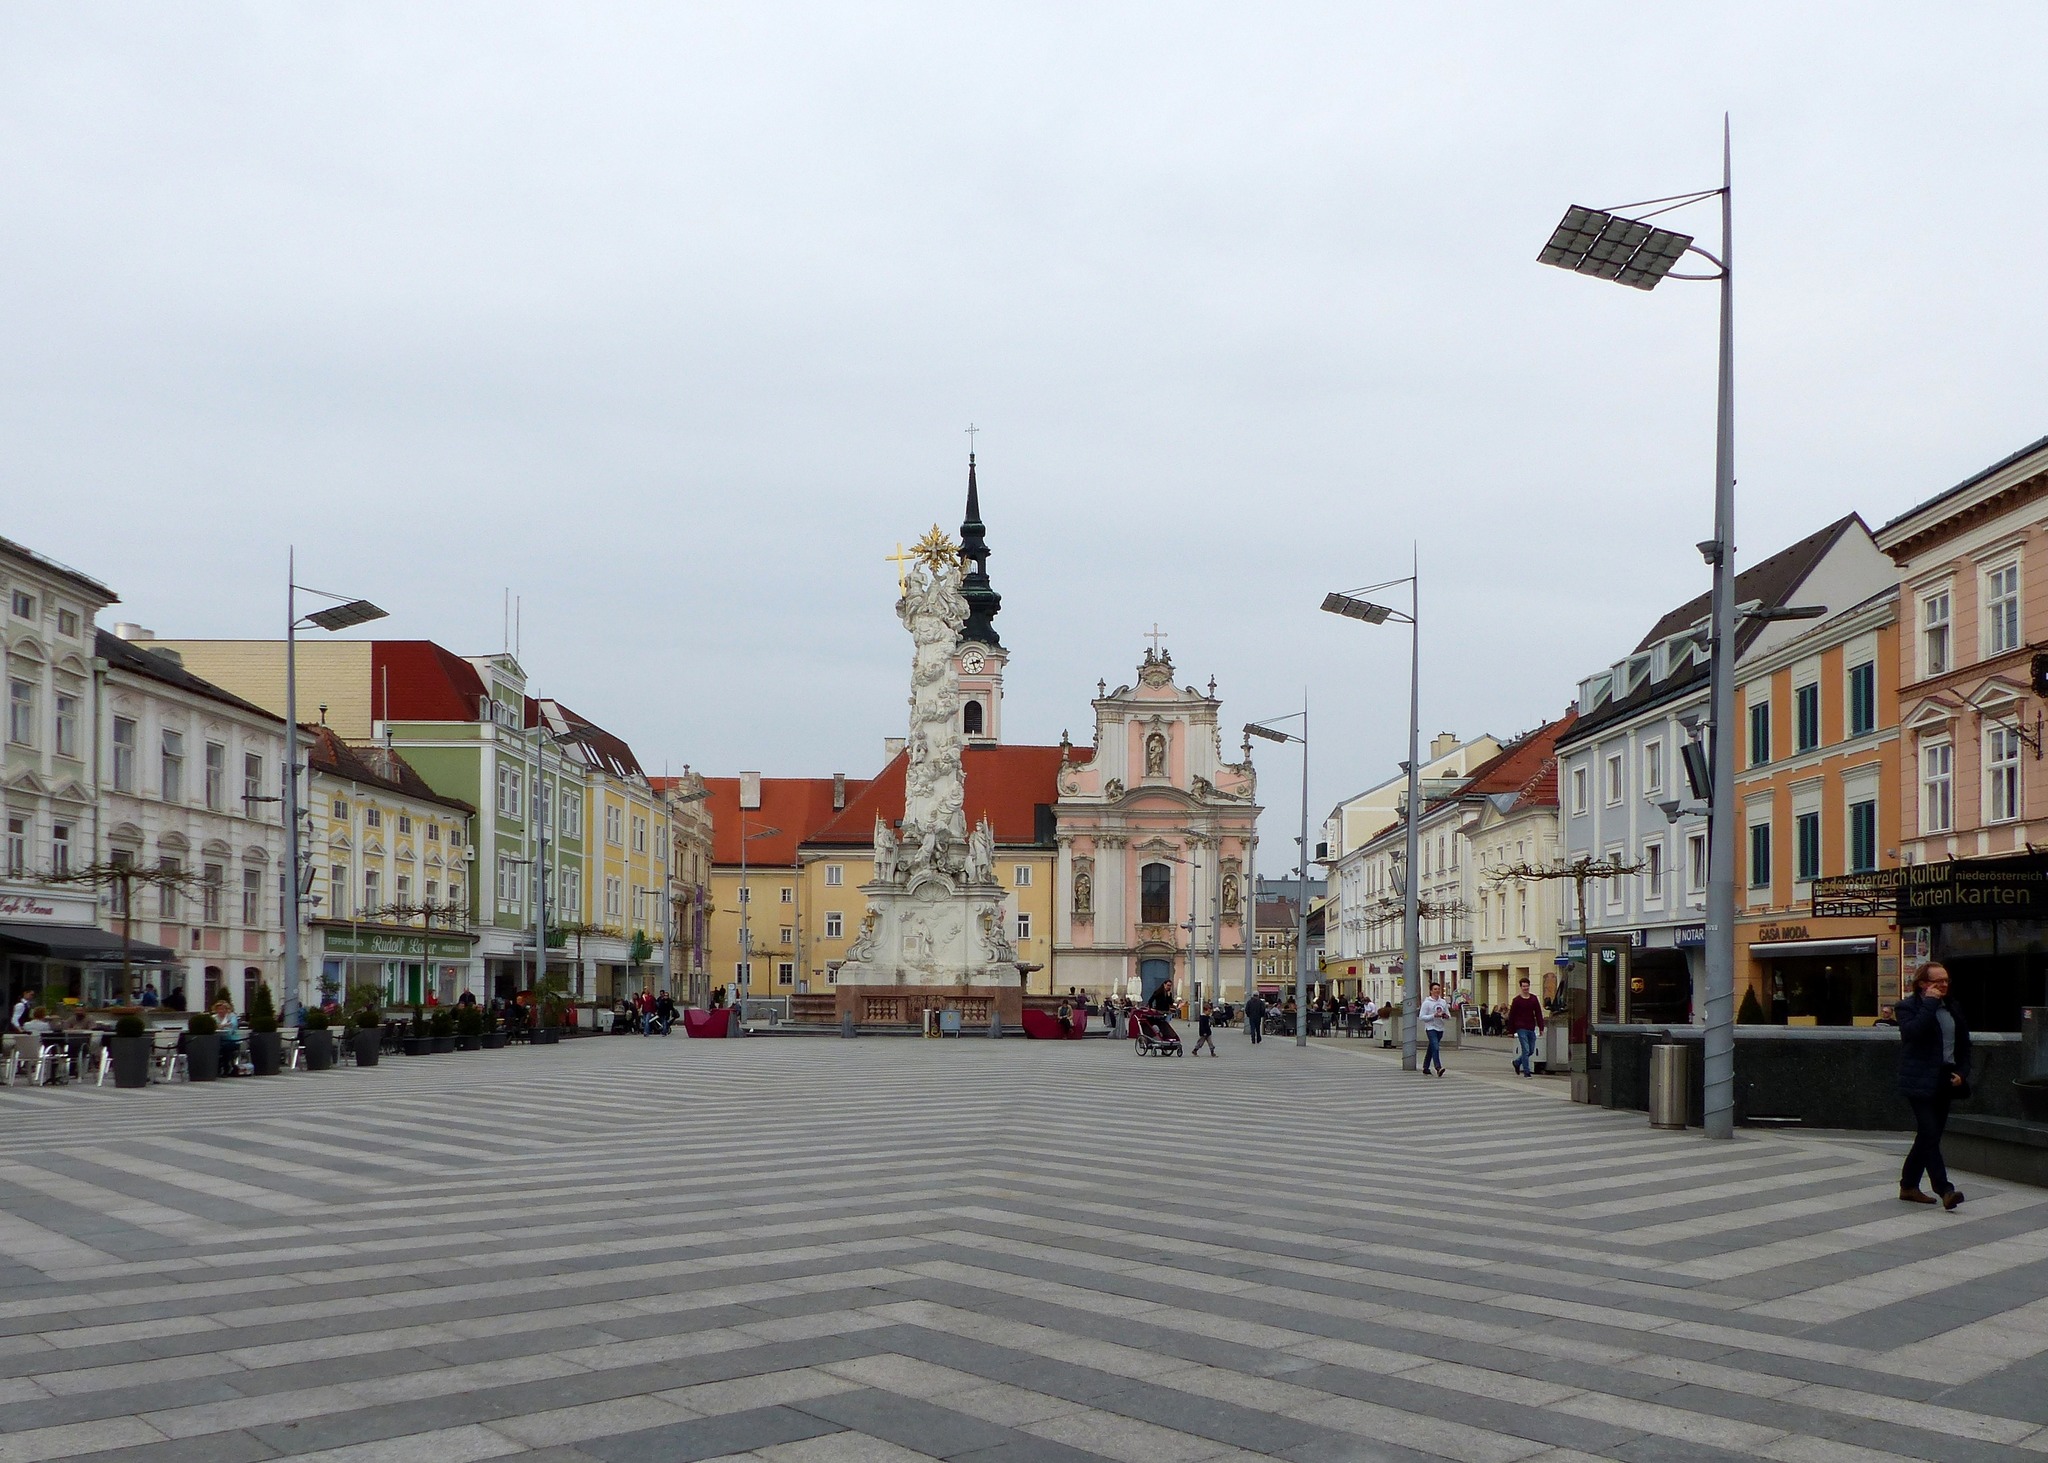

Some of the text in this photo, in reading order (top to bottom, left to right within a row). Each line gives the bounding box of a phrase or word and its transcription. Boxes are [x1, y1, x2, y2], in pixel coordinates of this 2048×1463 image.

[1909, 863, 1950, 885] kultur
[1956, 870, 2043, 881] niederösterreich
[1909, 886, 1951, 907] karten
[1955, 882, 2031, 904] karten
[1681, 928, 1705, 941] NOTAR
[1759, 928, 1780, 941] CASA
[371, 935, 437, 954] Rudolf Leier
[1602, 949, 1616, 958] WC
